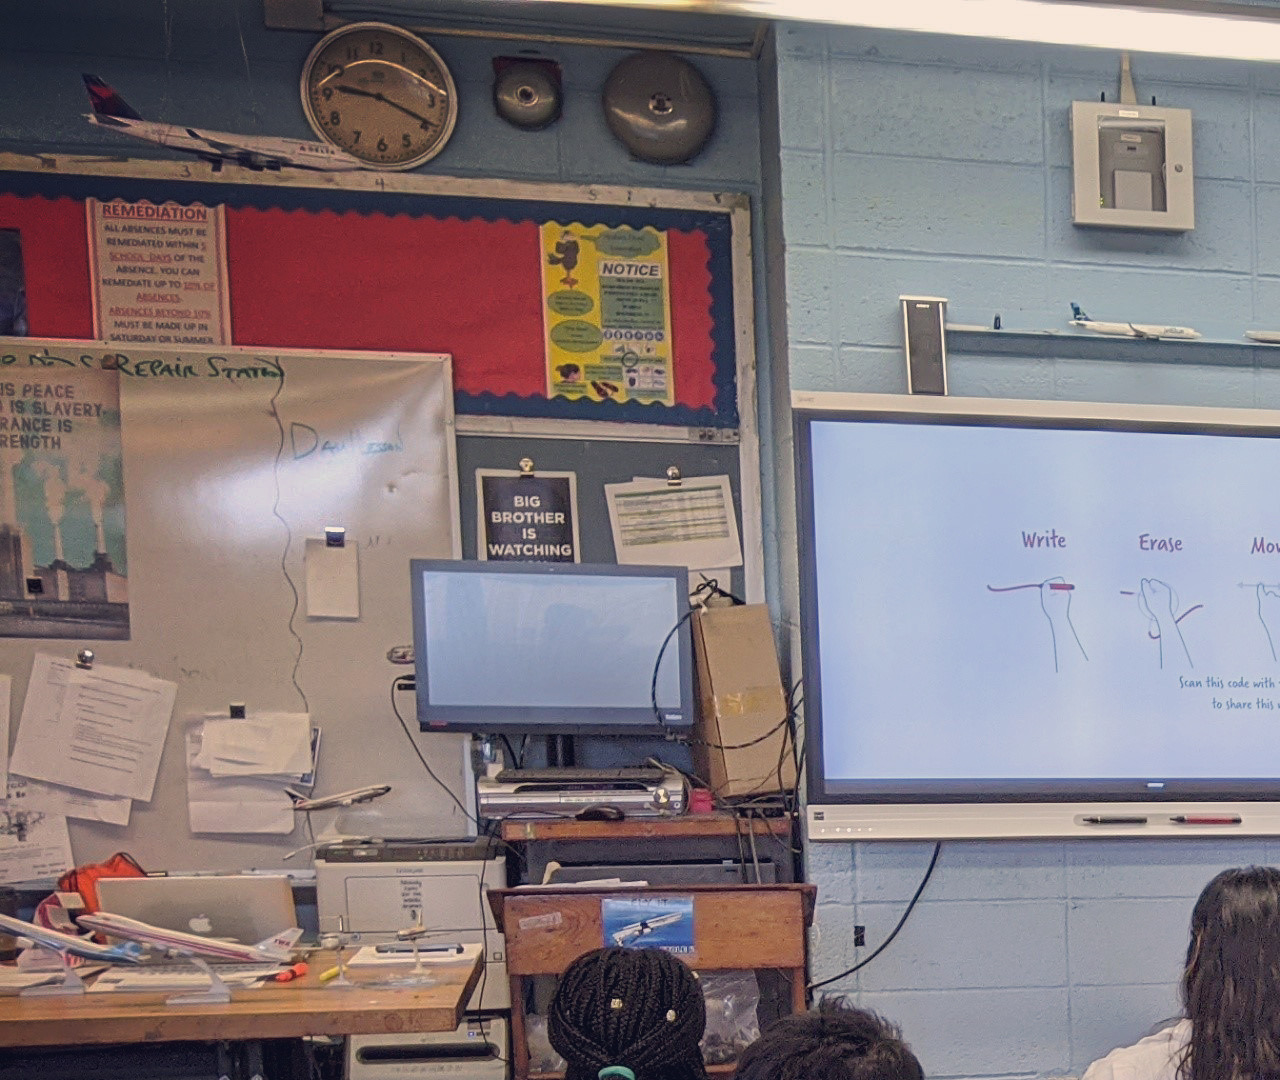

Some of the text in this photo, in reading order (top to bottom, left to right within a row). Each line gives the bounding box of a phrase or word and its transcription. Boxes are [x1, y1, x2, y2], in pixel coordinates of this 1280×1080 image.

[323, 87, 332, 99] 9
[331, 111, 340, 125] 8
[353, 131, 362, 143] 7
[402, 134, 411, 147] 5
[377, 138, 387, 151] 6
[102, 204, 207, 220] REMEDIATION
[121, 225, 166, 235] ABSENCES
[168, 227, 194, 236] MUST
[196, 228, 207, 236] BE
[107, 238, 164, 248] REMEDIATED
[166, 240, 199, 249] WITHIN
[189, 255, 205, 263] THE
[161, 267, 178, 275] YOU
[181, 268, 200, 276] CAN
[602, 263, 659, 276] NOTICE
[102, 278, 152, 288] REMEDIATE
[154, 280, 167, 288] UP
[170, 281, 181, 289] TO
[114, 321, 208, 331] MUST BE MADE UP IN
[110, 333, 155, 342] SATURDAY
[0, 383, 75, 399] IS PEACE
[10, 400, 25, 414] IS
[58, 420, 73, 433] IS
[514, 496, 541, 508] BIG
[491, 511, 565, 524] BROTHER
[522, 528, 537, 540] IS
[1021, 529, 1067, 548] Write
[1139, 533, 1183, 552] Erase
[489, 543, 572, 556] WATCHING
[1179, 676, 1202, 688] Scan
[1206, 677, 1224, 689] this
[1228, 677, 1250, 689] code
[1253, 677, 1275, 689] with
[1212, 698, 1222, 710] to
[1226, 698, 1252, 711] share
[1256, 698, 1274, 710] this
